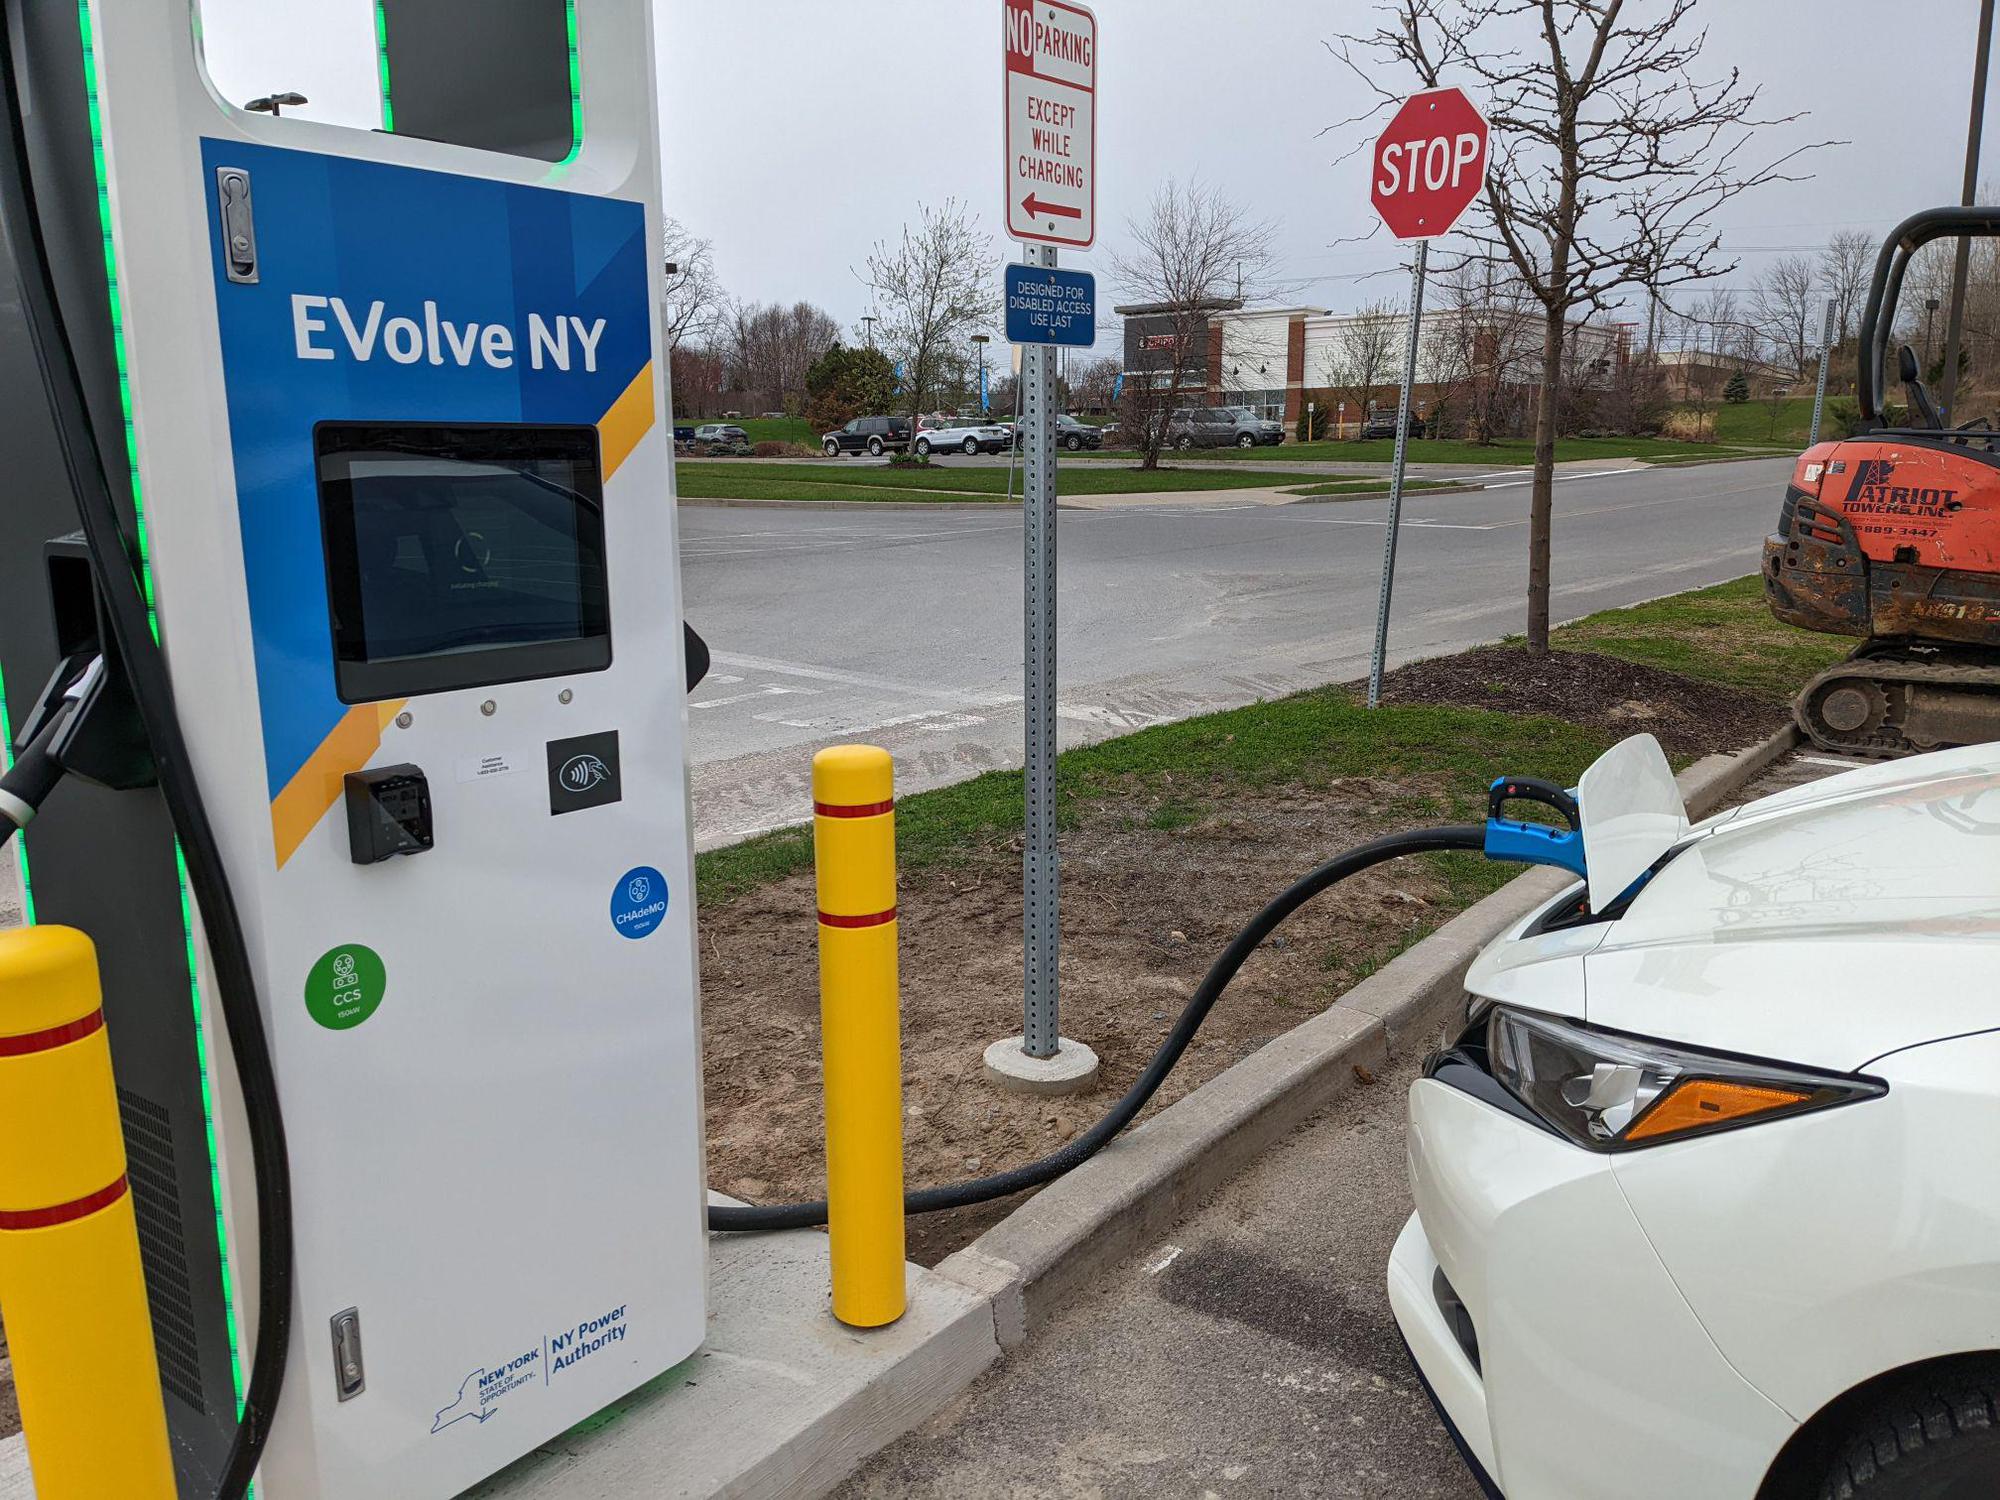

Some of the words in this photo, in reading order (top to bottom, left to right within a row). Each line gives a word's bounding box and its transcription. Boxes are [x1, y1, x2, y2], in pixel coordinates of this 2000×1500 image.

[1006, 5, 1032, 57] NO
[1035, 22, 1090, 67] PARKING
[1028, 96, 1075, 129] EXCEPT
[1032, 127, 1071, 158] WHILE
[1019, 155, 1083, 189] CHARGING
[1378, 132, 1480, 197] STOP
[1009, 295, 1054, 312] DISABLED
[1056, 301, 1091, 315] ACCESS
[1018, 281, 1063, 298] DESIGNED
[1065, 286, 1084, 300] FOR
[291, 293, 513, 369] EVolve
[528, 313, 606, 372] NY
[1030, 313, 1048, 326] USE
[1050, 314, 1072, 328] LAST
[1844, 460, 1958, 507] PATRIOT
[616, 901, 665, 924] CHAdeMO
[333, 988, 361, 1006] CCS
[552, 1329, 575, 1354] NY
[579, 1304, 626, 1339] Power
[552, 1323, 627, 1374] Authority
[479, 1366, 507, 1388] NEW
[507, 1348, 539, 1373] YORK
[480, 1379, 504, 1398] STATE
[504, 1374, 514, 1385] OF
